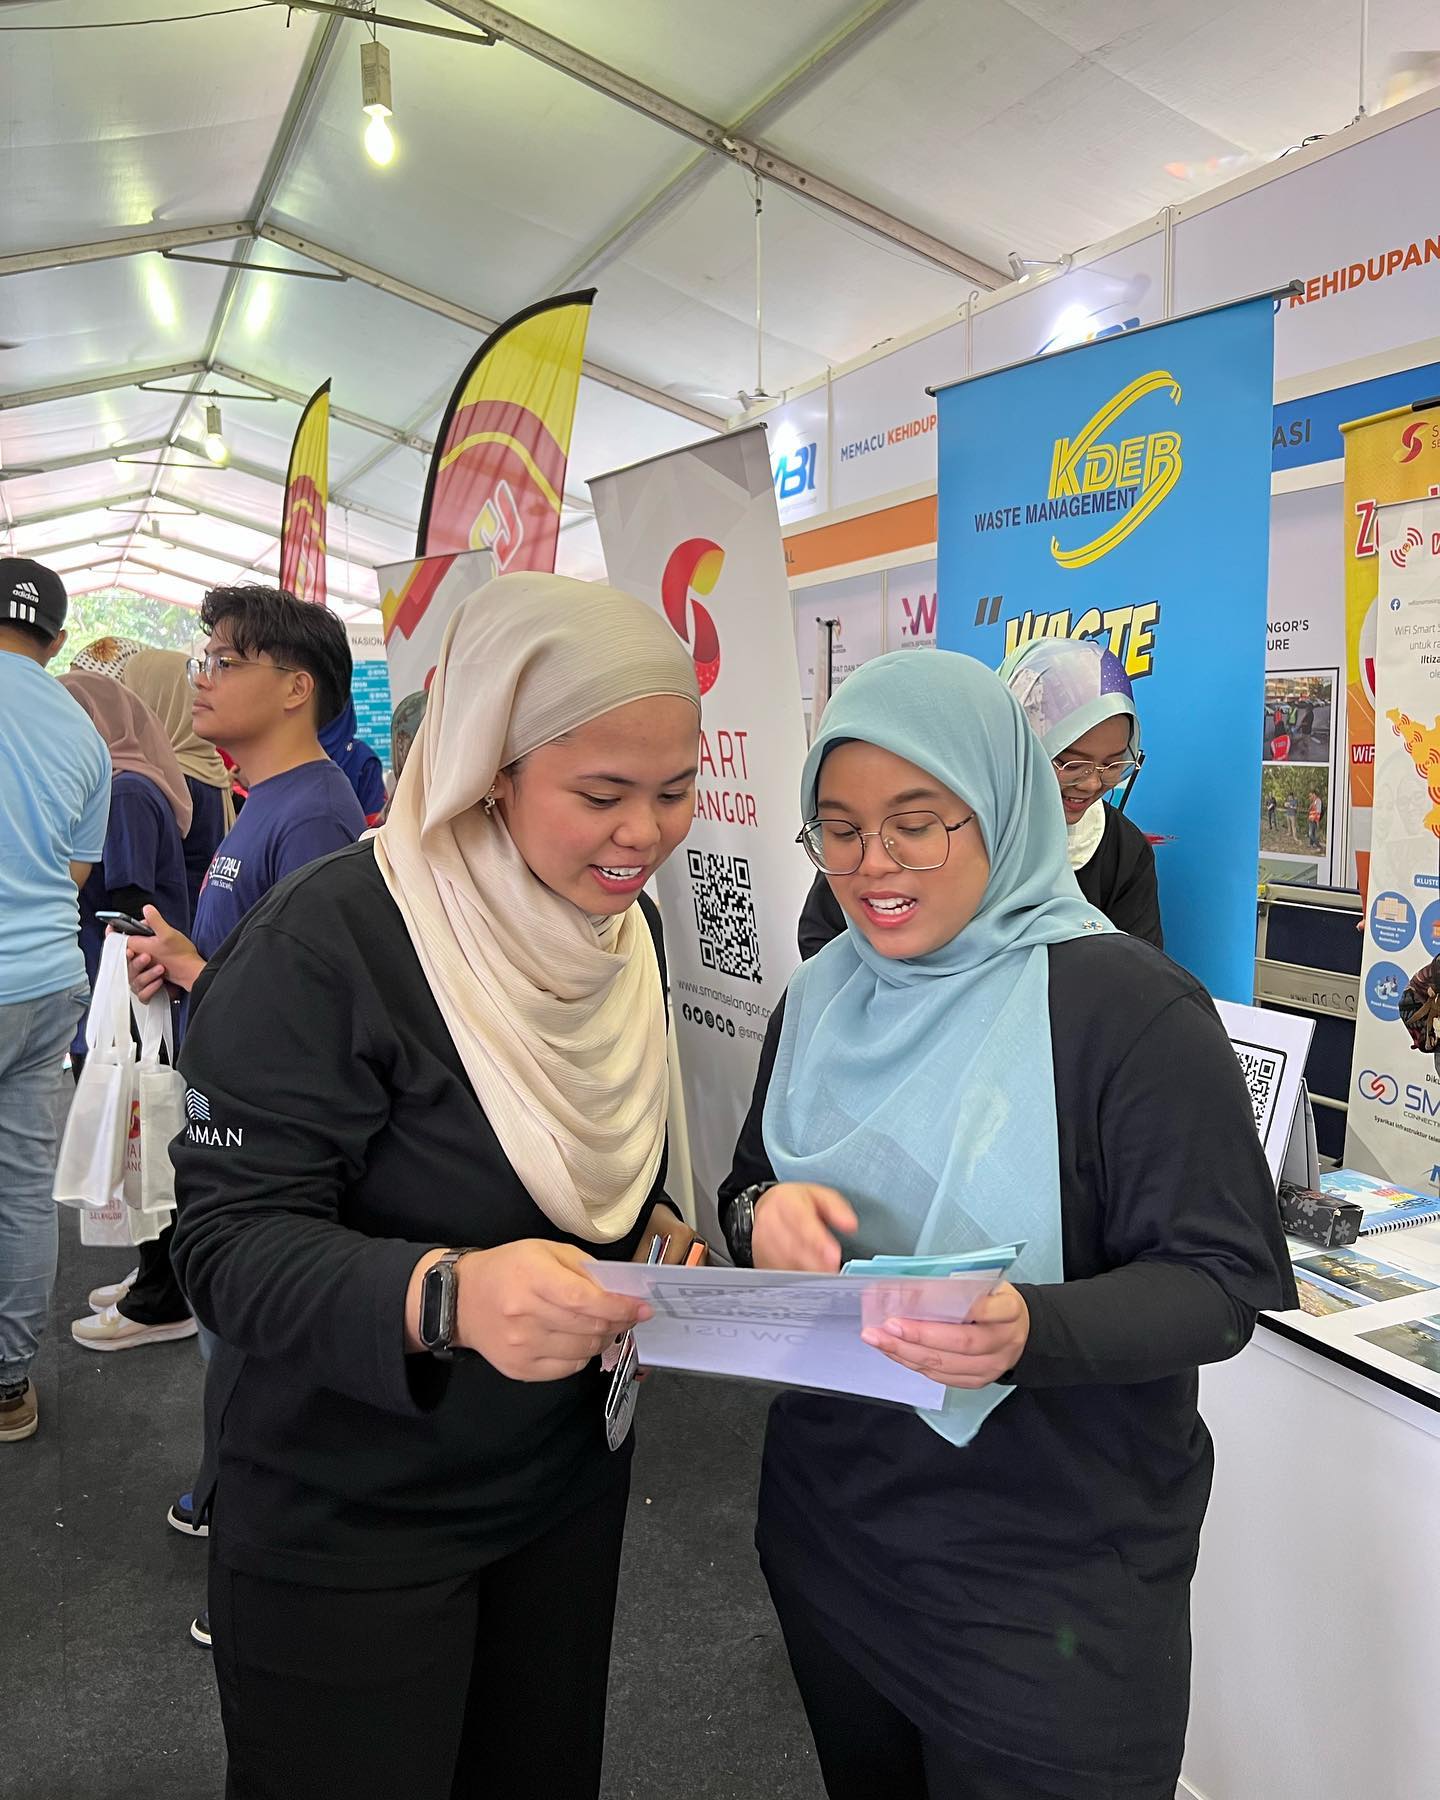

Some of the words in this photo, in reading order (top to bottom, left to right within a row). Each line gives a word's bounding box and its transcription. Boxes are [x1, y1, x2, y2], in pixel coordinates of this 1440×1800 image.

[840, 433, 886, 462] MEMACU
[887, 414, 937, 446] KEHIDUP
[1047, 431, 1183, 500] KDEB
[974, 506, 1021, 533] WASTE
[1025, 486, 1138, 525] MANAGEMENT
[12, 588, 39, 604] adidas
[1409, 639, 1432, 650] untuk
[1412, 624, 1436, 635] Smart
[700, 731, 748, 780] ART
[694, 789, 758, 828] ANGOR
[186, 1123, 243, 1147] AMAN
[1373, 1115, 1395, 1129] Syarikat
[1395, 1122, 1428, 1139] infrastruktur
